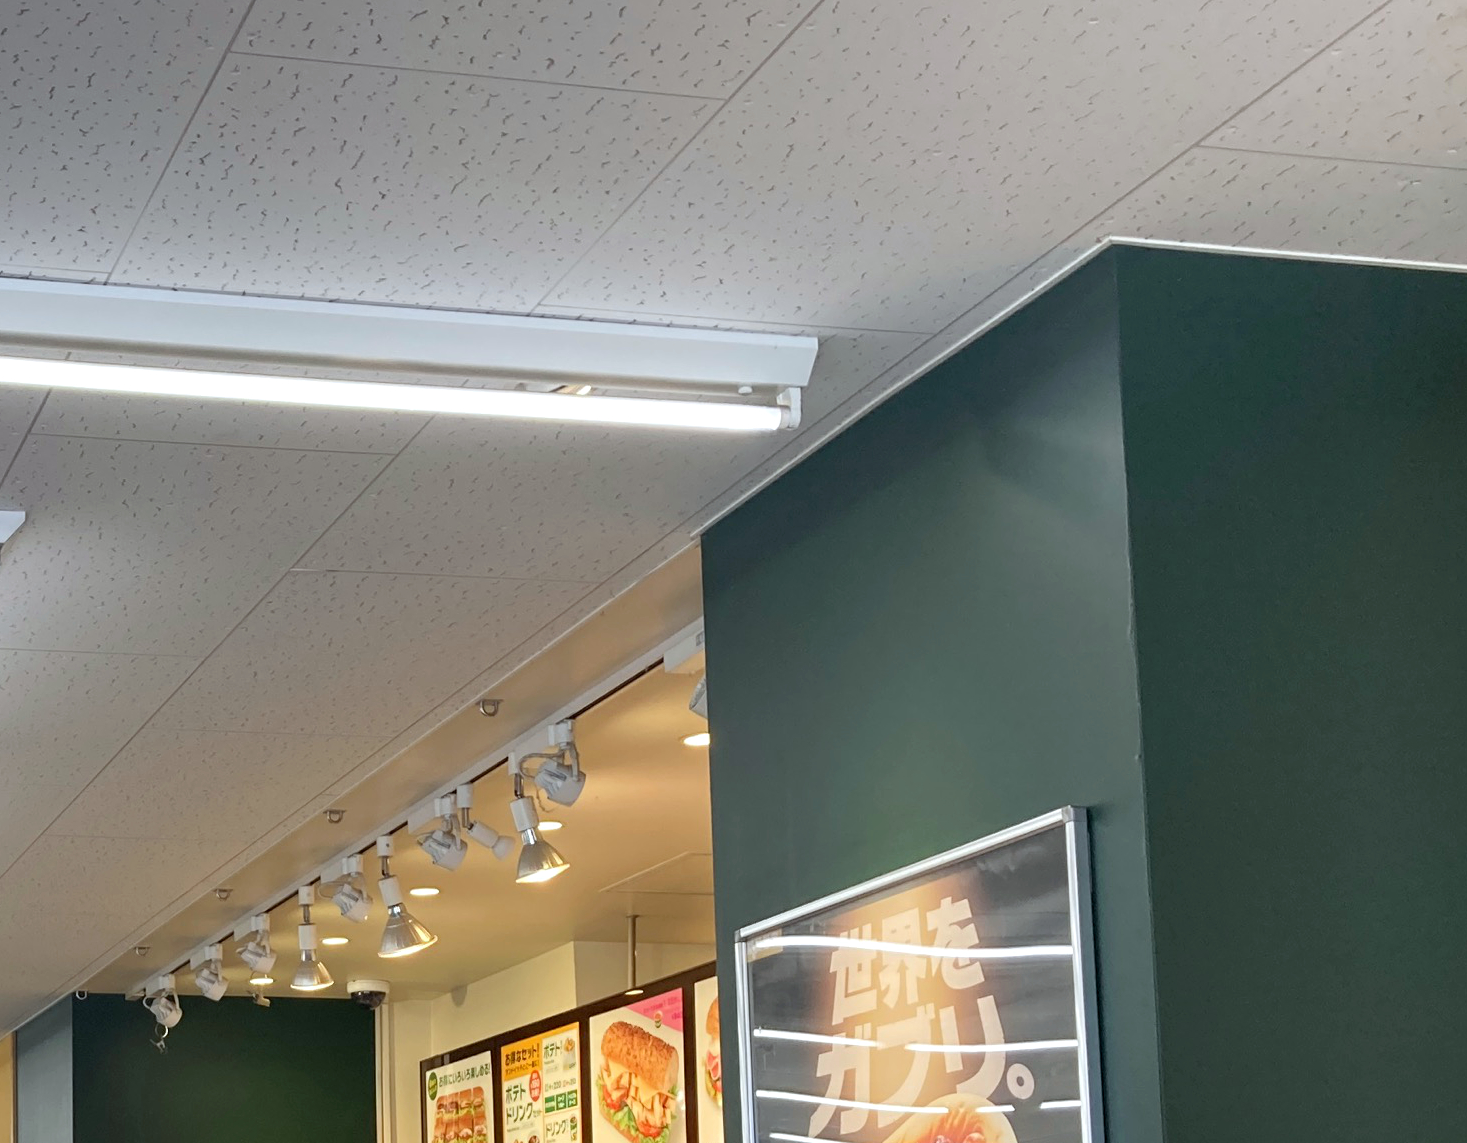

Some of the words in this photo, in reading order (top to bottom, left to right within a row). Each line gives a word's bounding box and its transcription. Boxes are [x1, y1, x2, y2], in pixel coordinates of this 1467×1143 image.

[829, 897, 984, 1024] 世界を
[506, 1084, 526, 1104] ポテト
[808, 995, 1035, 1137] ガブリ。
